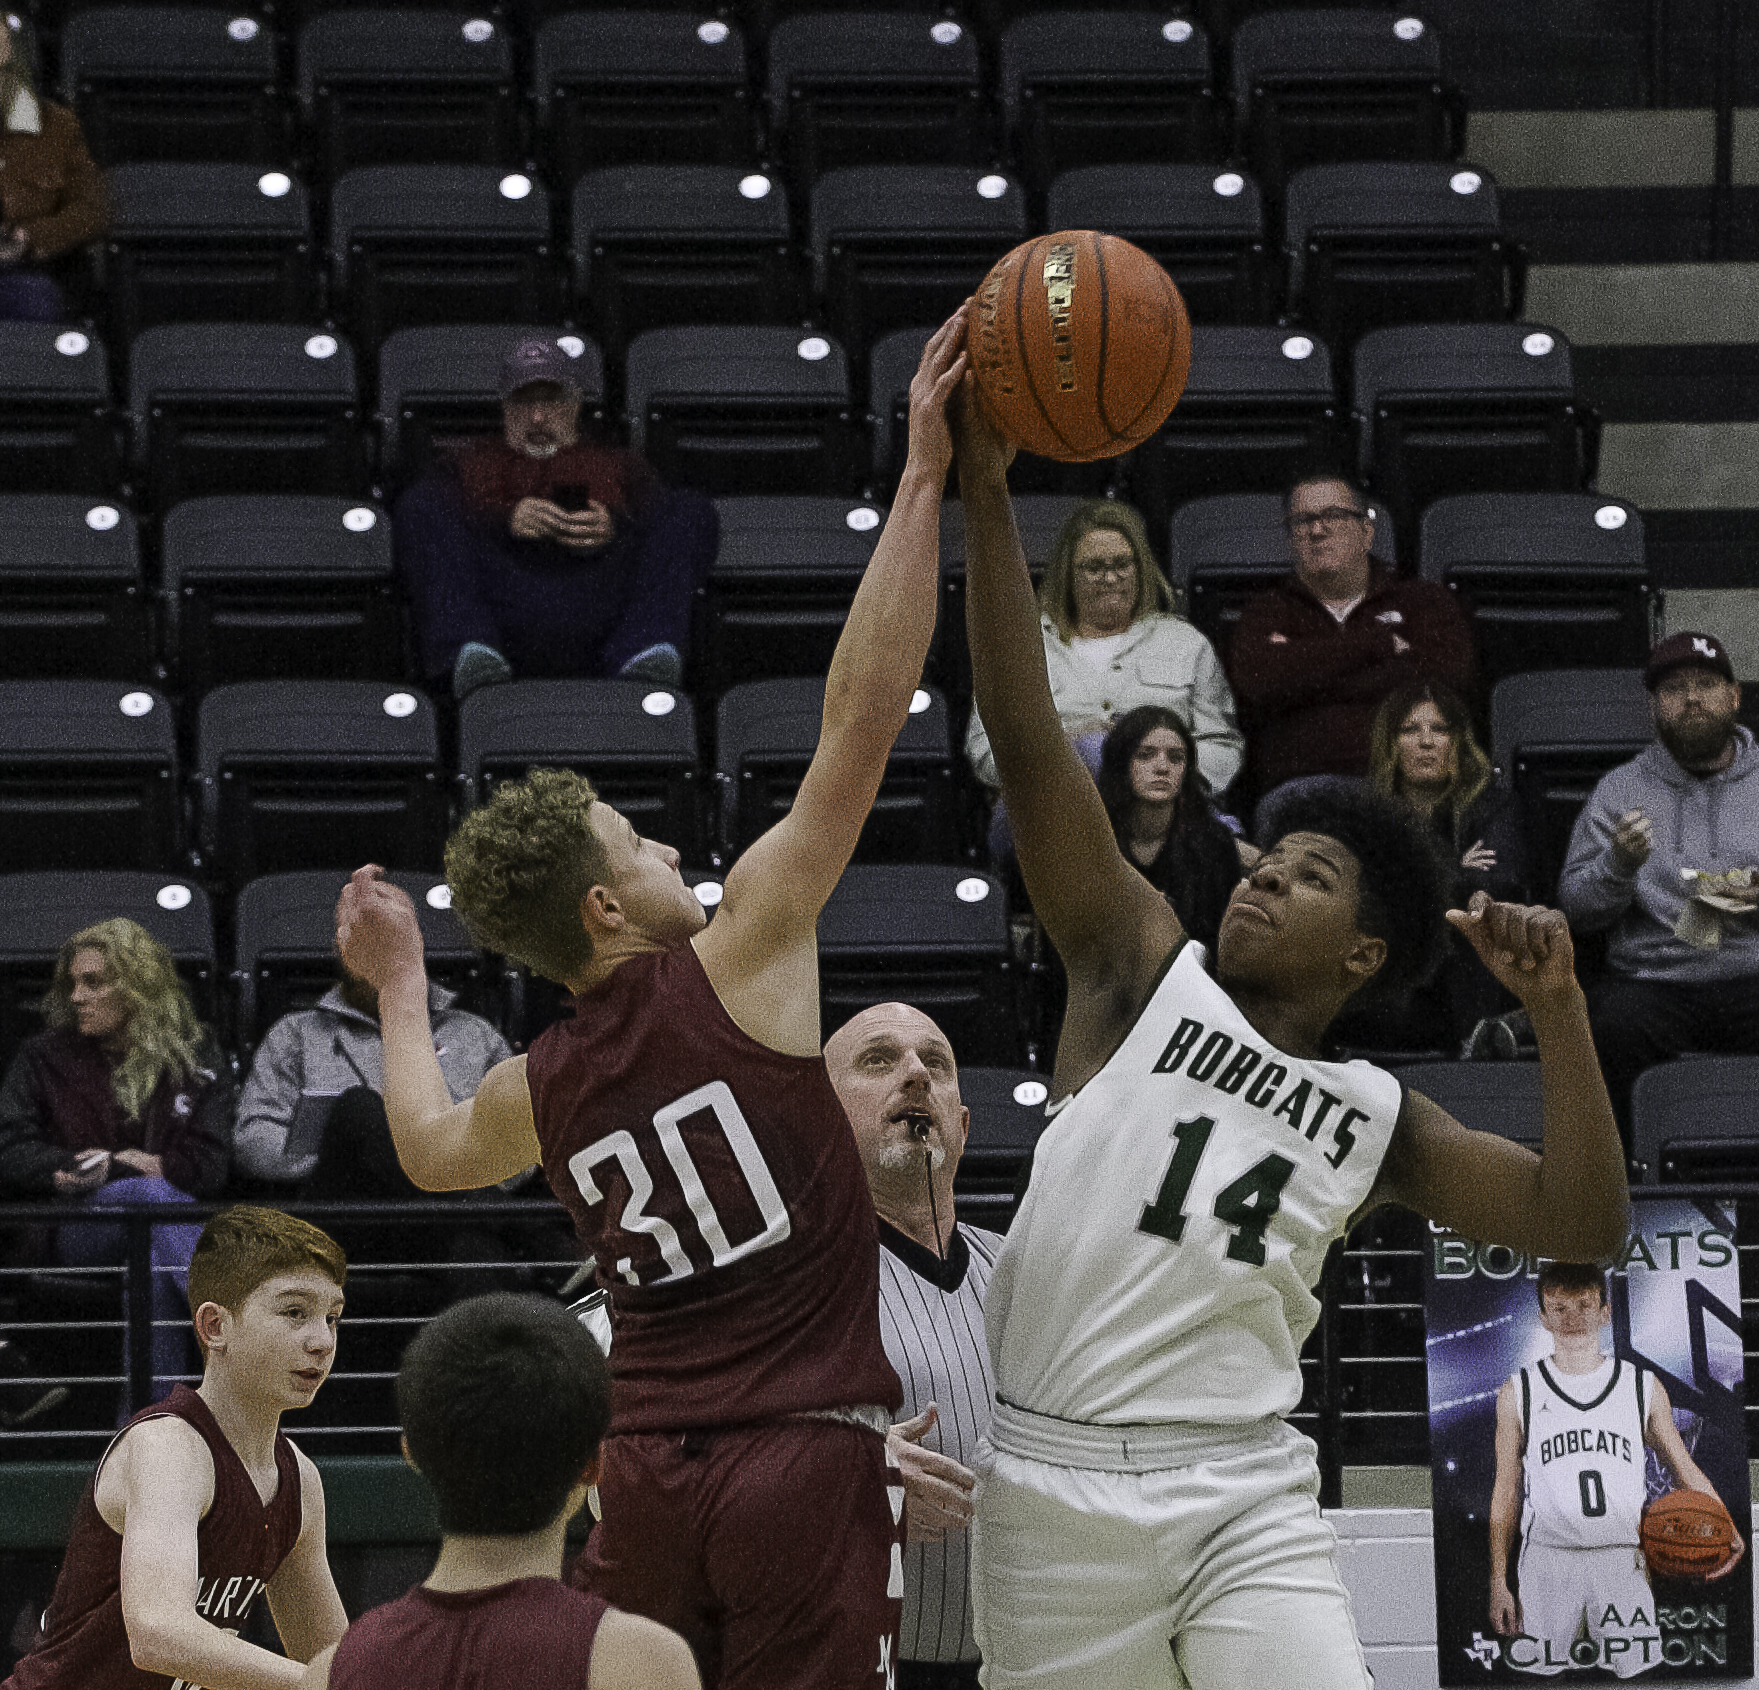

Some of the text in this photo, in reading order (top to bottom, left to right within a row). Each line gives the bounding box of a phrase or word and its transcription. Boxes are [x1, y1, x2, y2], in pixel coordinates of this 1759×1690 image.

[1151, 1016, 1371, 1170] BOBCATS
[568, 1080, 791, 1286] 30
[1136, 1113, 1297, 1268] 14
[1433, 1229, 1734, 1280] BOATS
[1541, 1429, 1632, 1466] BOBCATS
[1578, 1469, 1607, 1518] 0
[1600, 1603, 1728, 1630] AARON
[1503, 1635, 1728, 1673] CLOPTON
